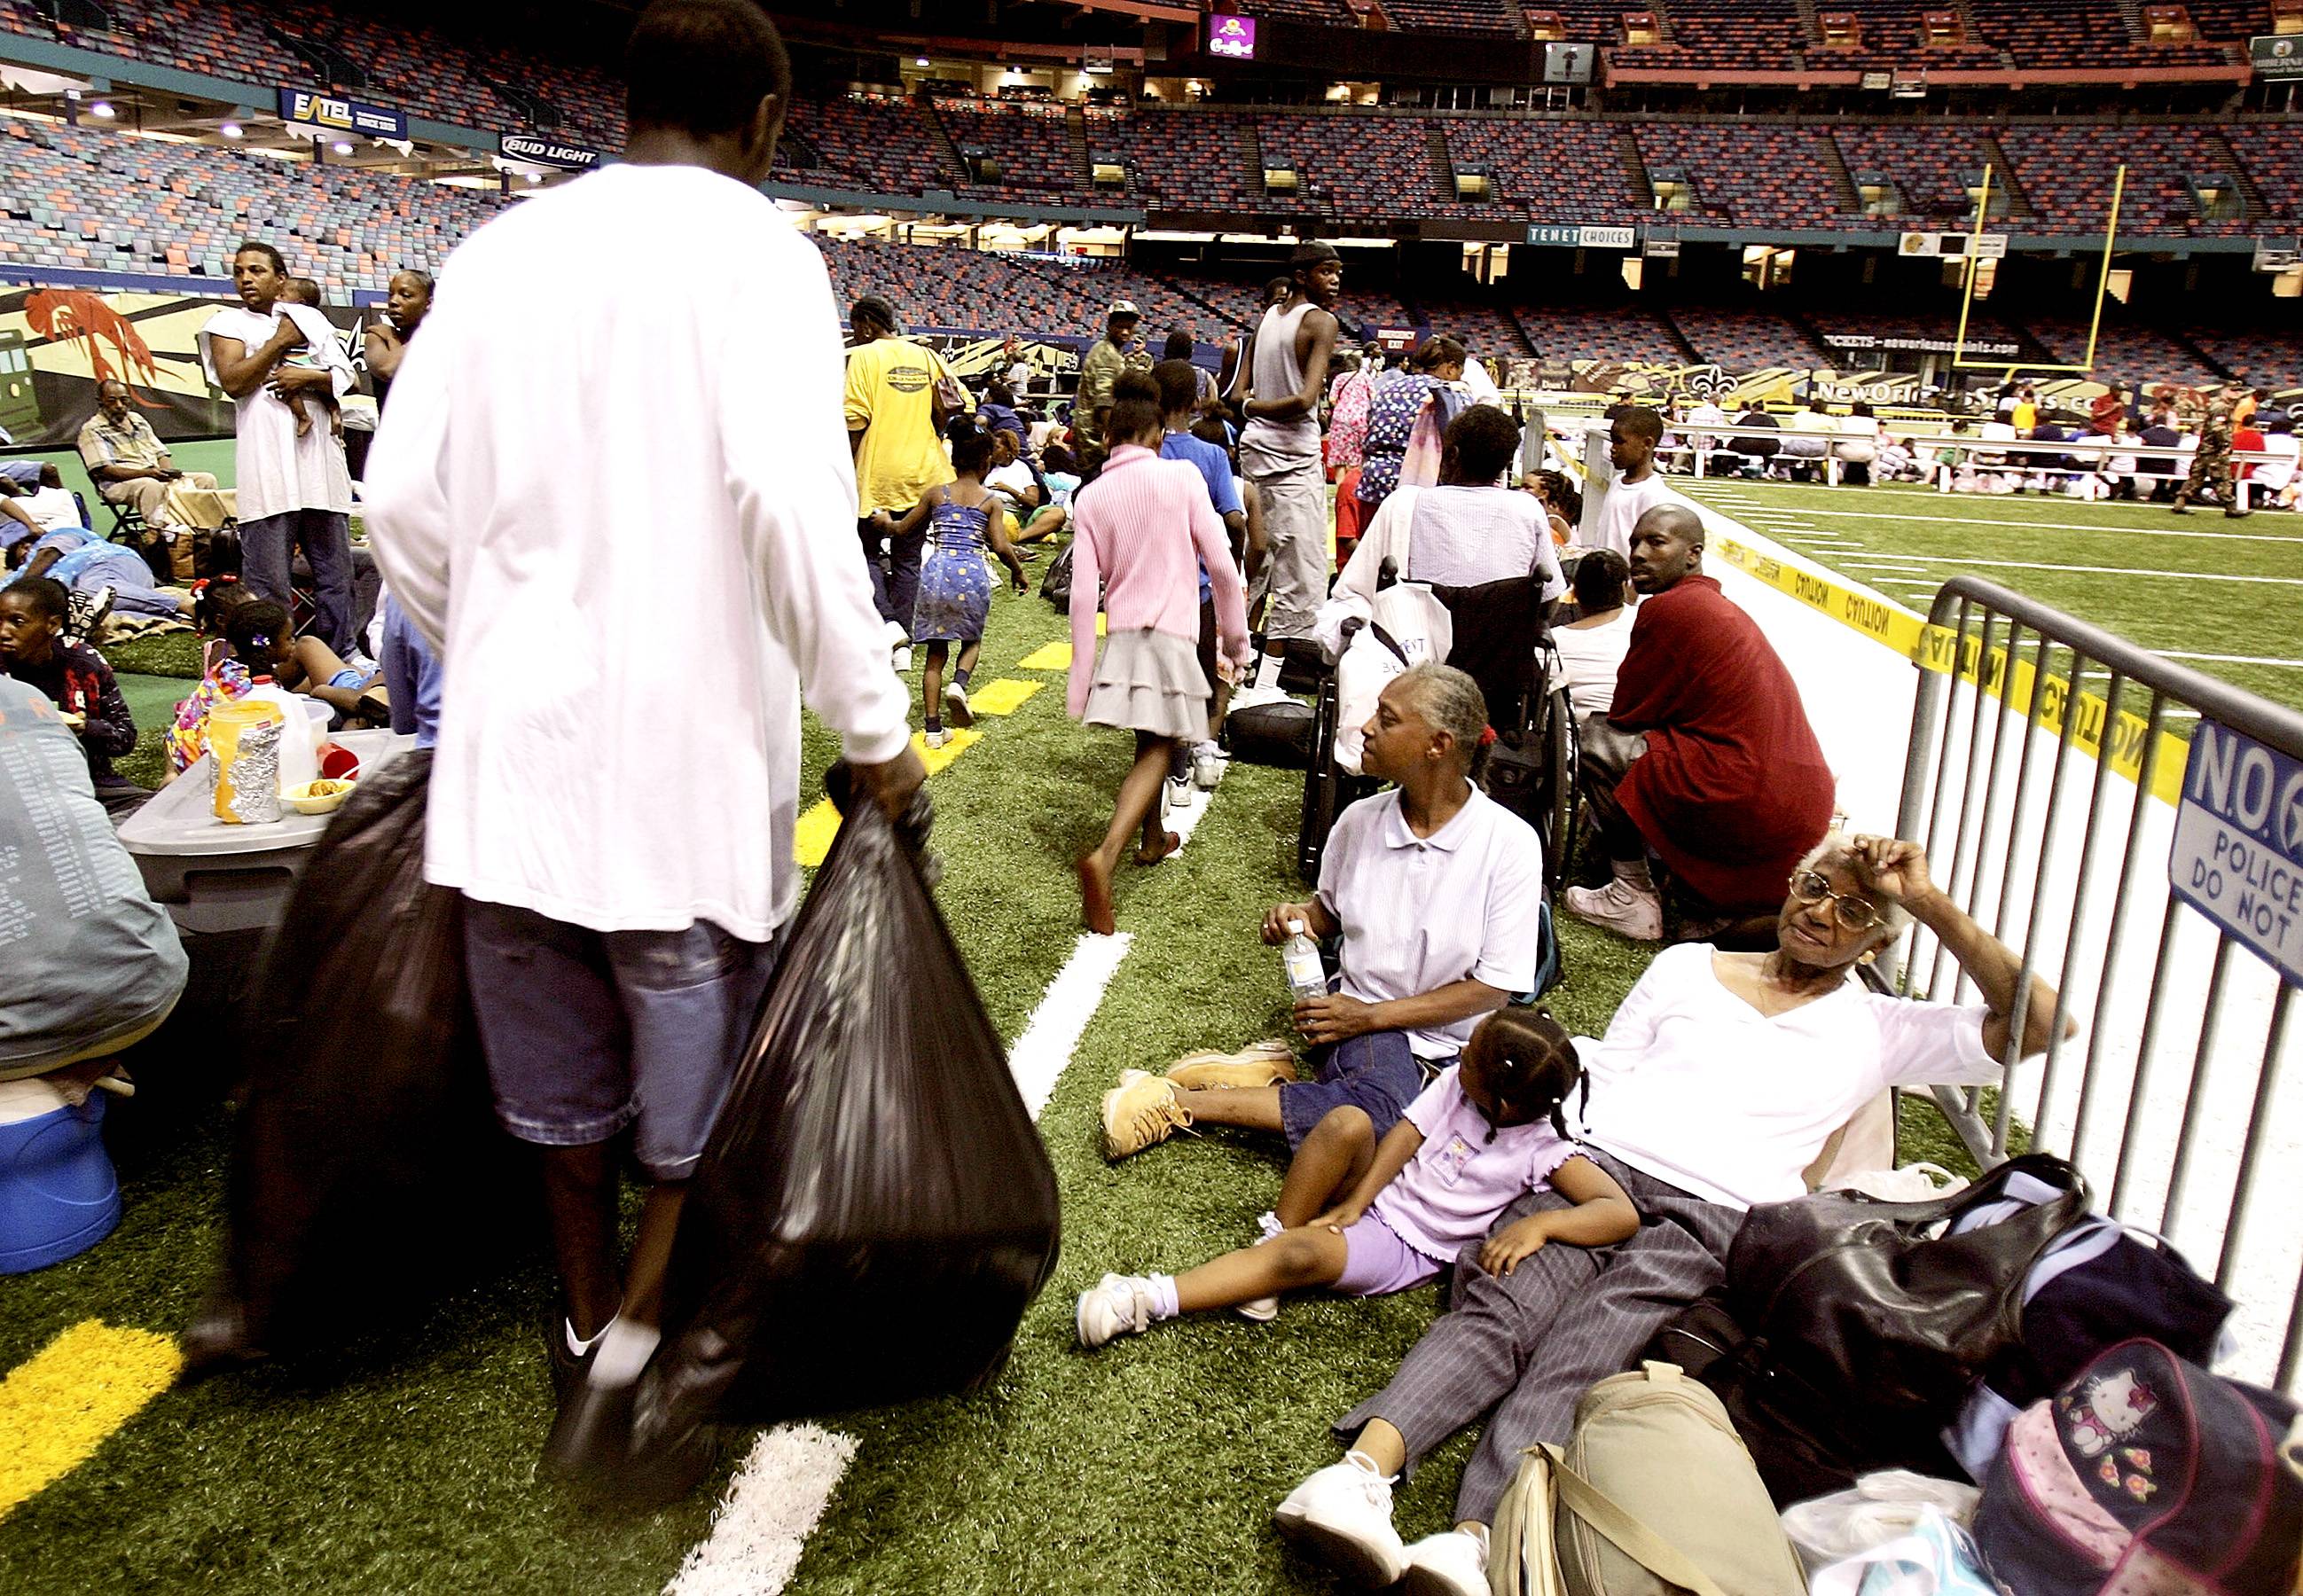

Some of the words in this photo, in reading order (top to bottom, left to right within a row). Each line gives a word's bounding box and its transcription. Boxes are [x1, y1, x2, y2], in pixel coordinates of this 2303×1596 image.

[294, 93, 353, 128] EATEL
[506, 139, 545, 155] BUD
[546, 146, 596, 163] LIGHT
[1531, 228, 1578, 242] TENET
[1584, 230, 1630, 243] CHOICES
[2213, 829, 2302, 915] POLICE
[2191, 857, 2223, 901] DO
[2237, 889, 2291, 949] NOT
